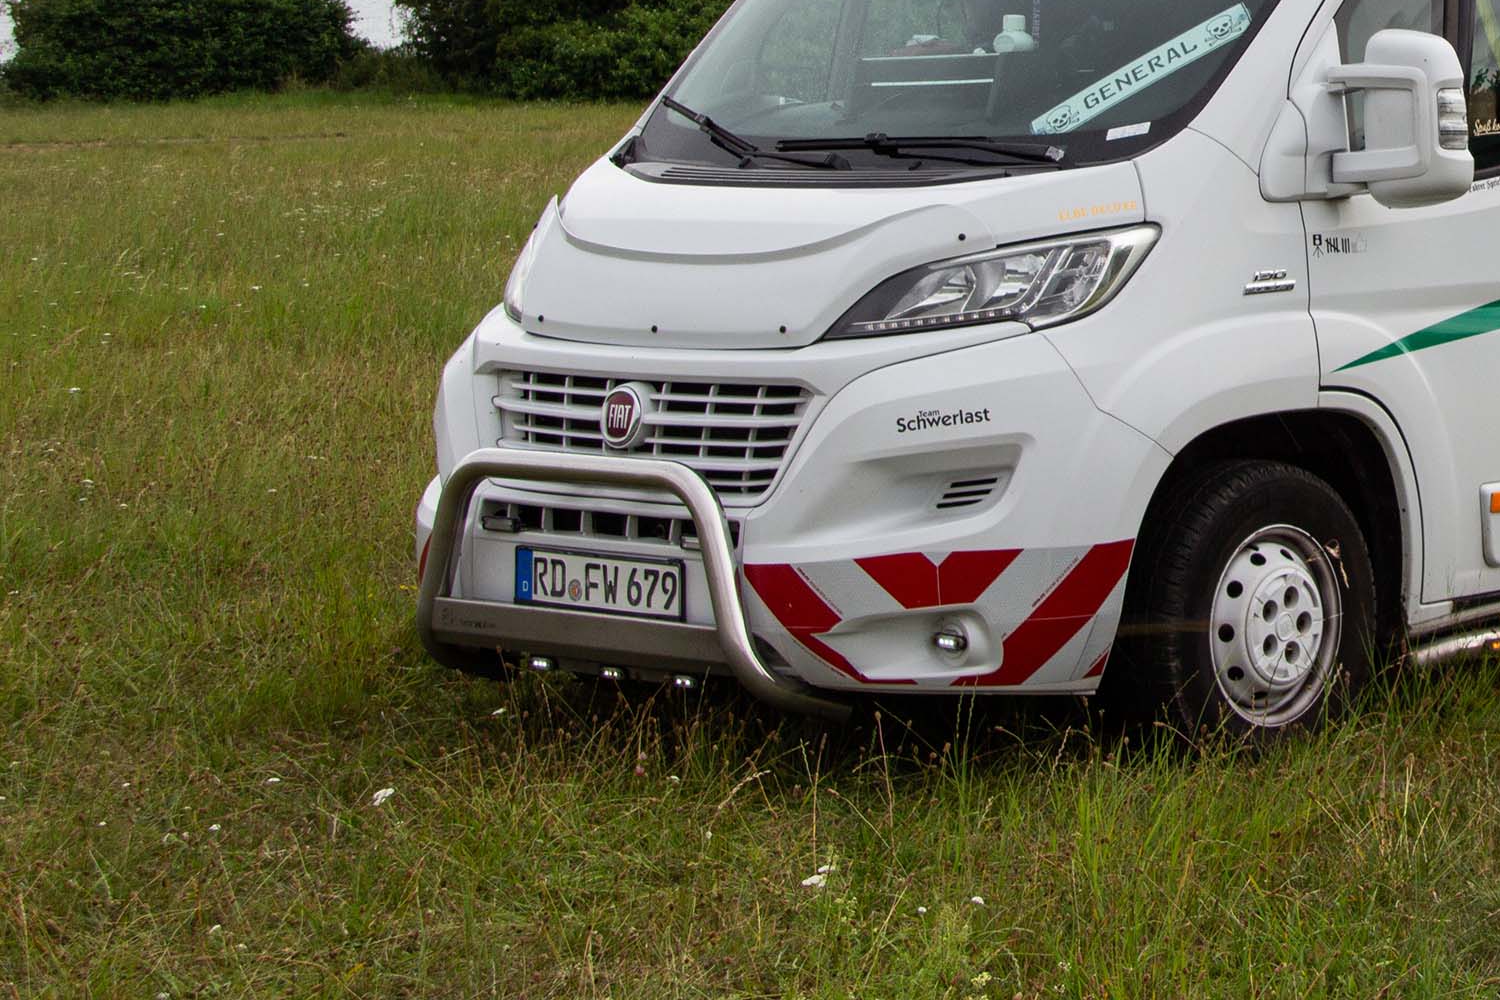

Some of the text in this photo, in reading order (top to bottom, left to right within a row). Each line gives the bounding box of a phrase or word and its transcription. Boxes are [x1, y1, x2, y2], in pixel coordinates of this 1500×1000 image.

[1083, 40, 1199, 110] GENERAL
[608, 404, 632, 429] FIAT
[896, 408, 991, 433] Schwerlast
[918, 409, 940, 417] Team
[522, 580, 529, 592] D
[533, 556, 678, 611] RD FW 679
